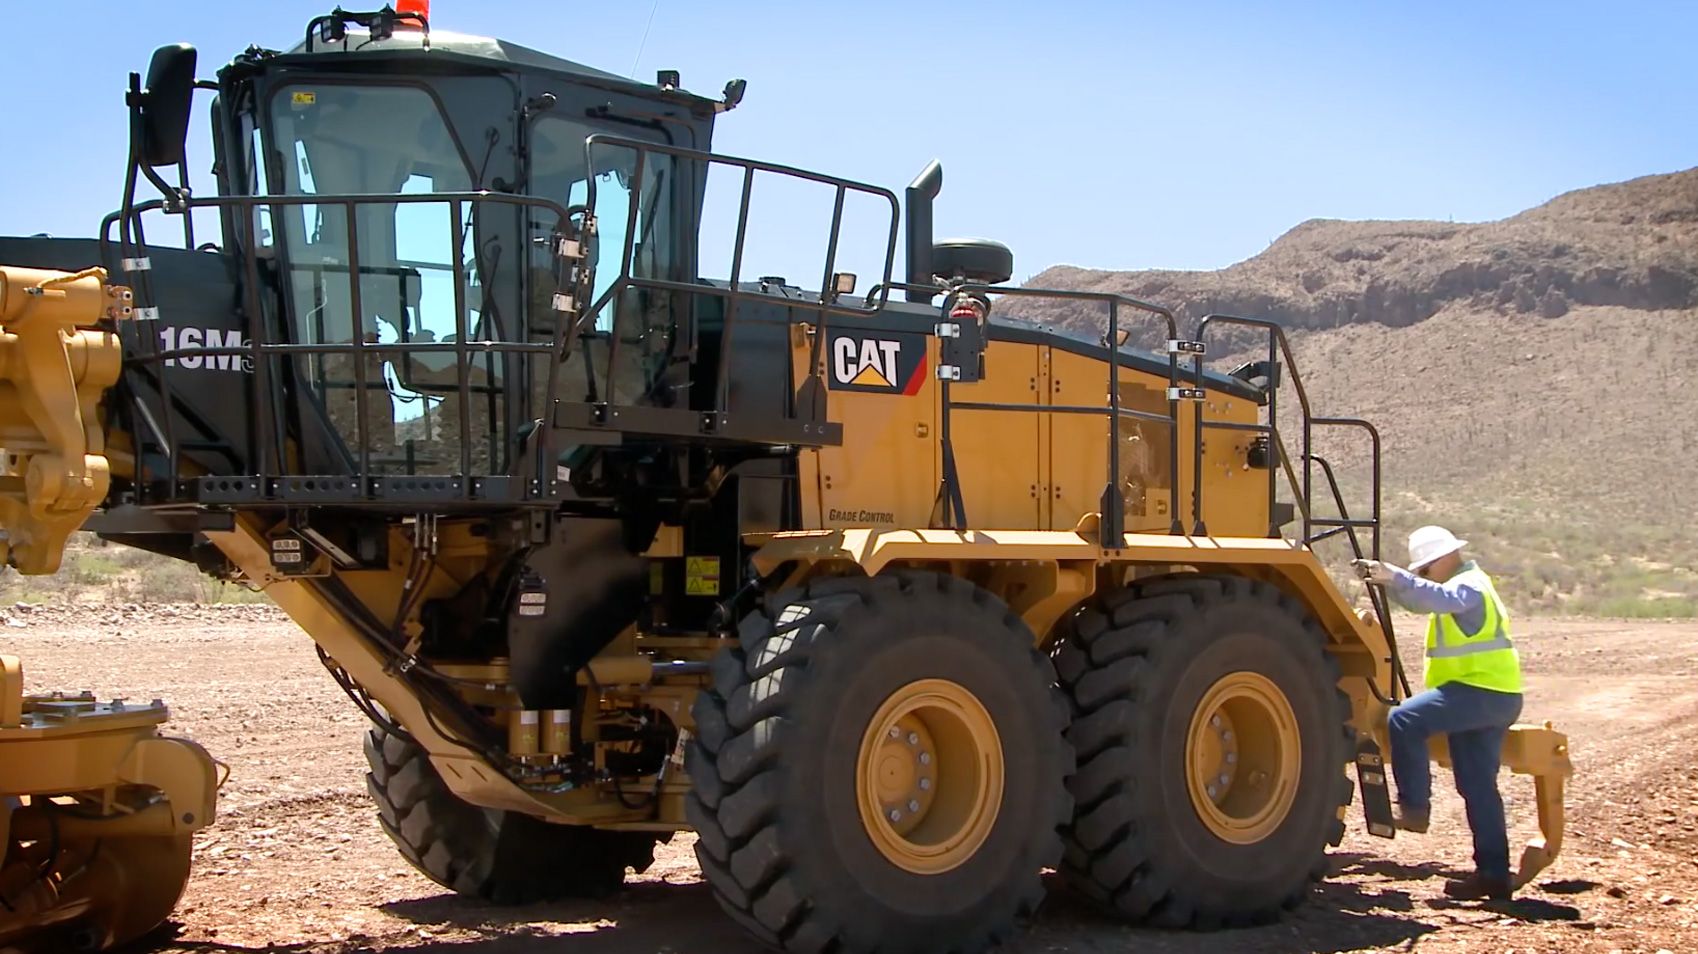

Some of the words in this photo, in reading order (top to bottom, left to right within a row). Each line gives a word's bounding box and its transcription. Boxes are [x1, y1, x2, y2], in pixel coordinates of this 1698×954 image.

[833, 336, 901, 387] CAT
[829, 508, 857, 522] GRADE
[858, 509, 895, 524] CONTROL
